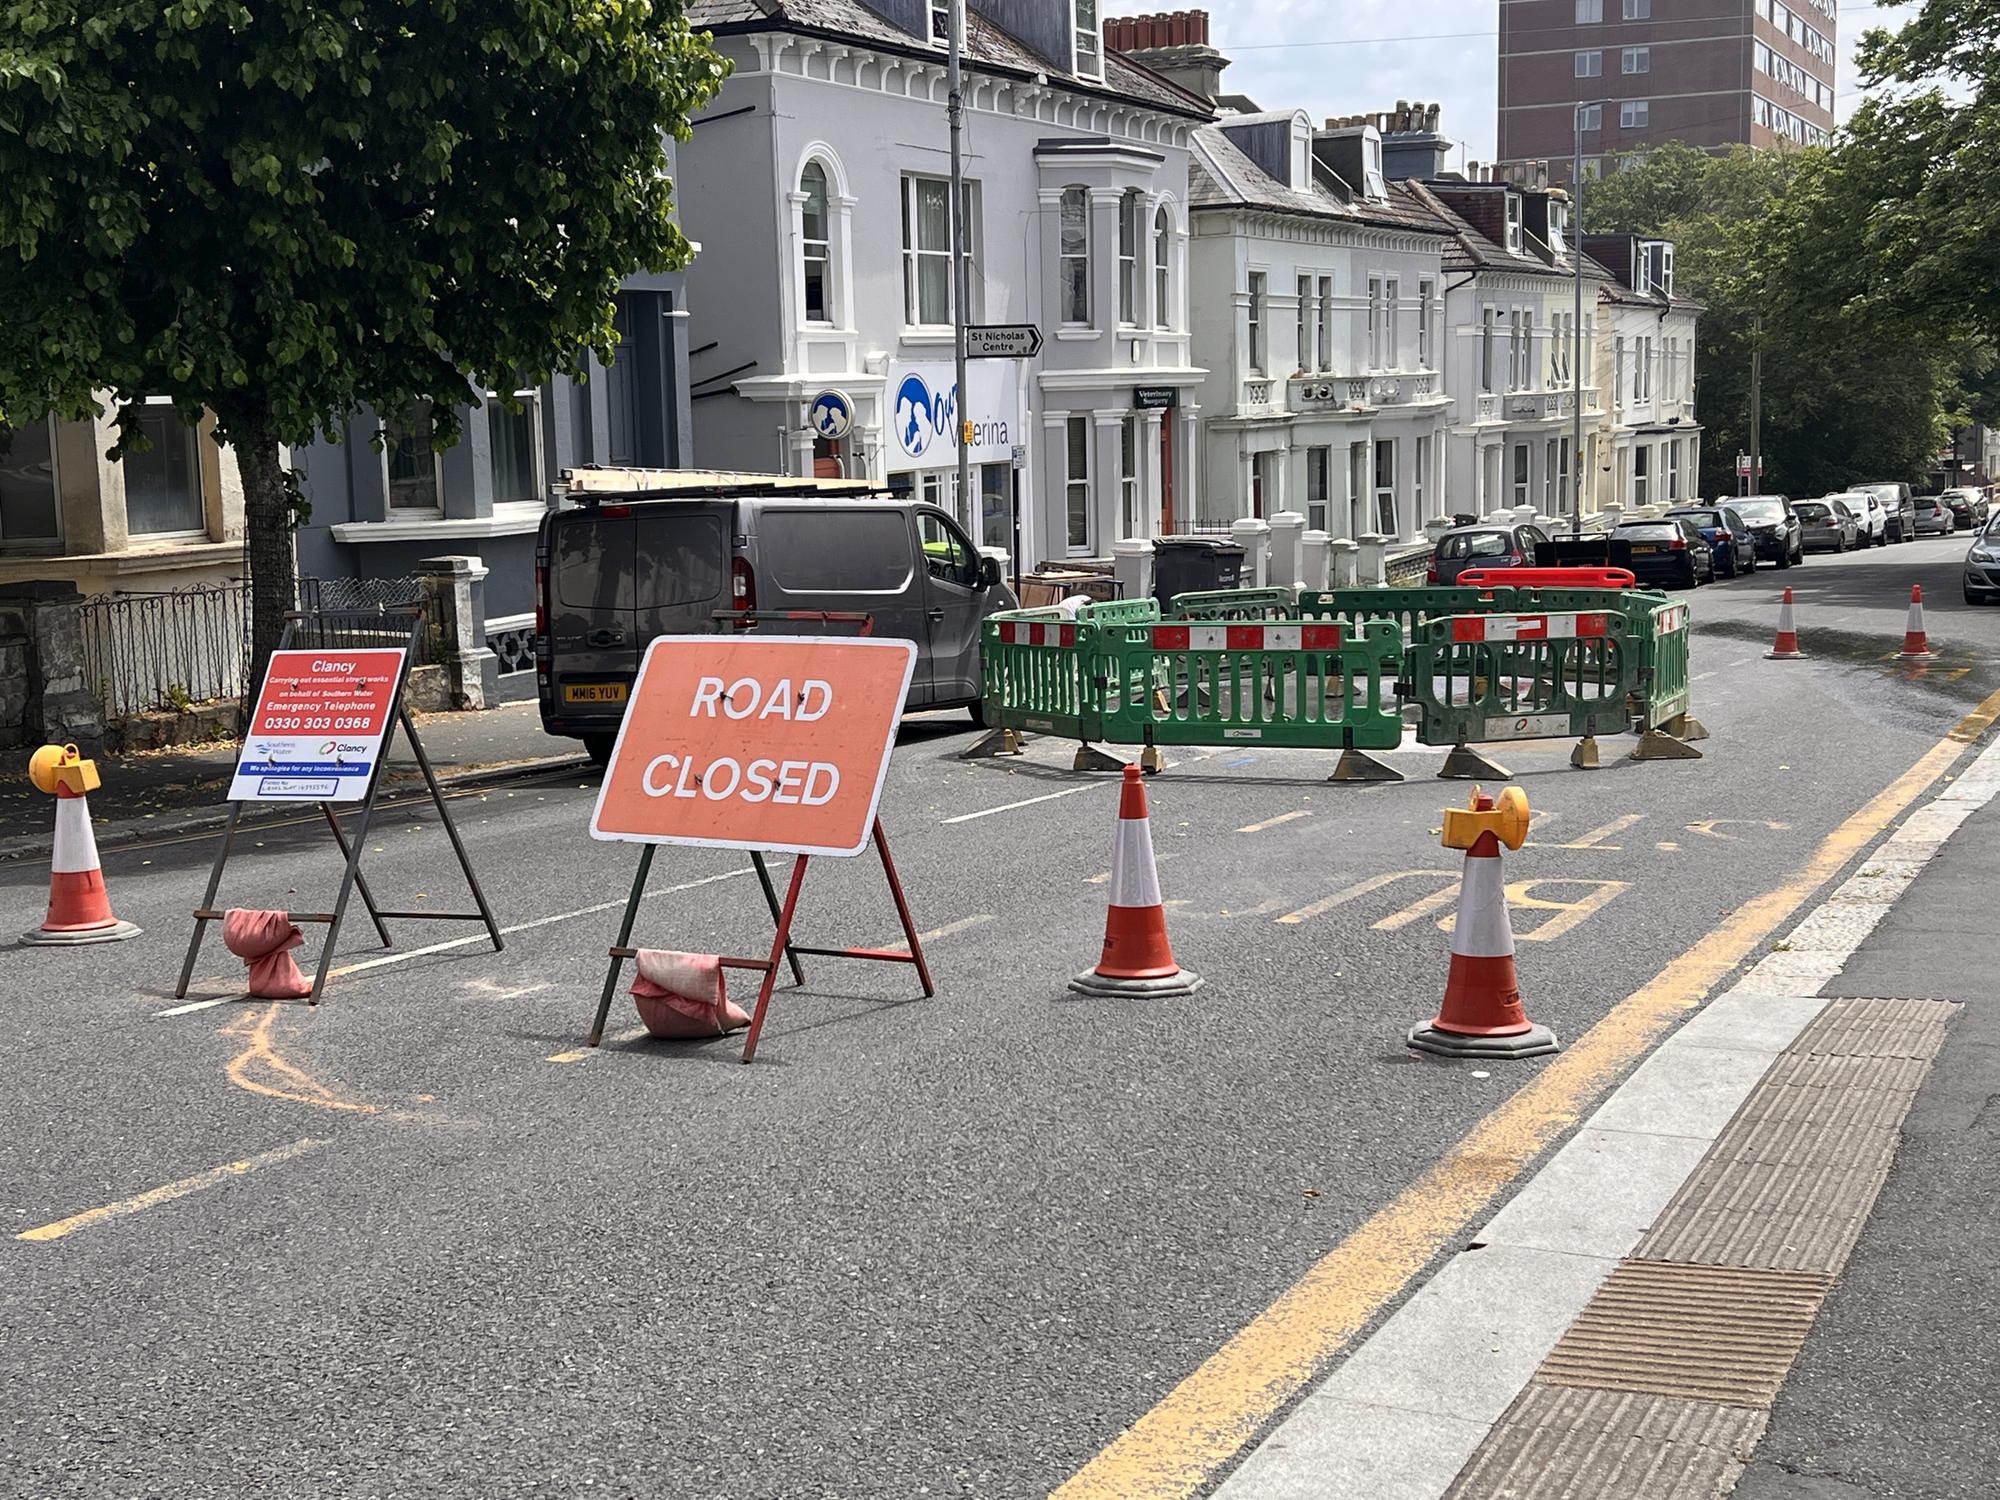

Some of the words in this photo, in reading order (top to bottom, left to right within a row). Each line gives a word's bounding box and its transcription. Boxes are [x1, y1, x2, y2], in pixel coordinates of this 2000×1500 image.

[971, 332, 982, 341] St
[985, 331, 1025, 341] Nicholas
[982, 342, 1014, 351] Centre
[1138, 390, 1173, 398] Veterinary
[1143, 398, 1169, 406] Surgery
[946, 415, 1009, 448] Verina
[311, 660, 357, 674] Clancy
[269, 676, 299, 685] Carrying
[289, 689, 312, 697] behalf
[572, 687, 596, 700] MM16
[598, 686, 620, 699] YUV
[689, 676, 833, 722] ROAD
[266, 701, 321, 713] Emergency
[324, 701, 376, 712] Telephone
[264, 717, 301, 729] 0330
[303, 717, 332, 729] 303
[334, 717, 371, 729] 0368
[336, 743, 367, 754] Clancy
[642, 754, 840, 807] CLOSED
